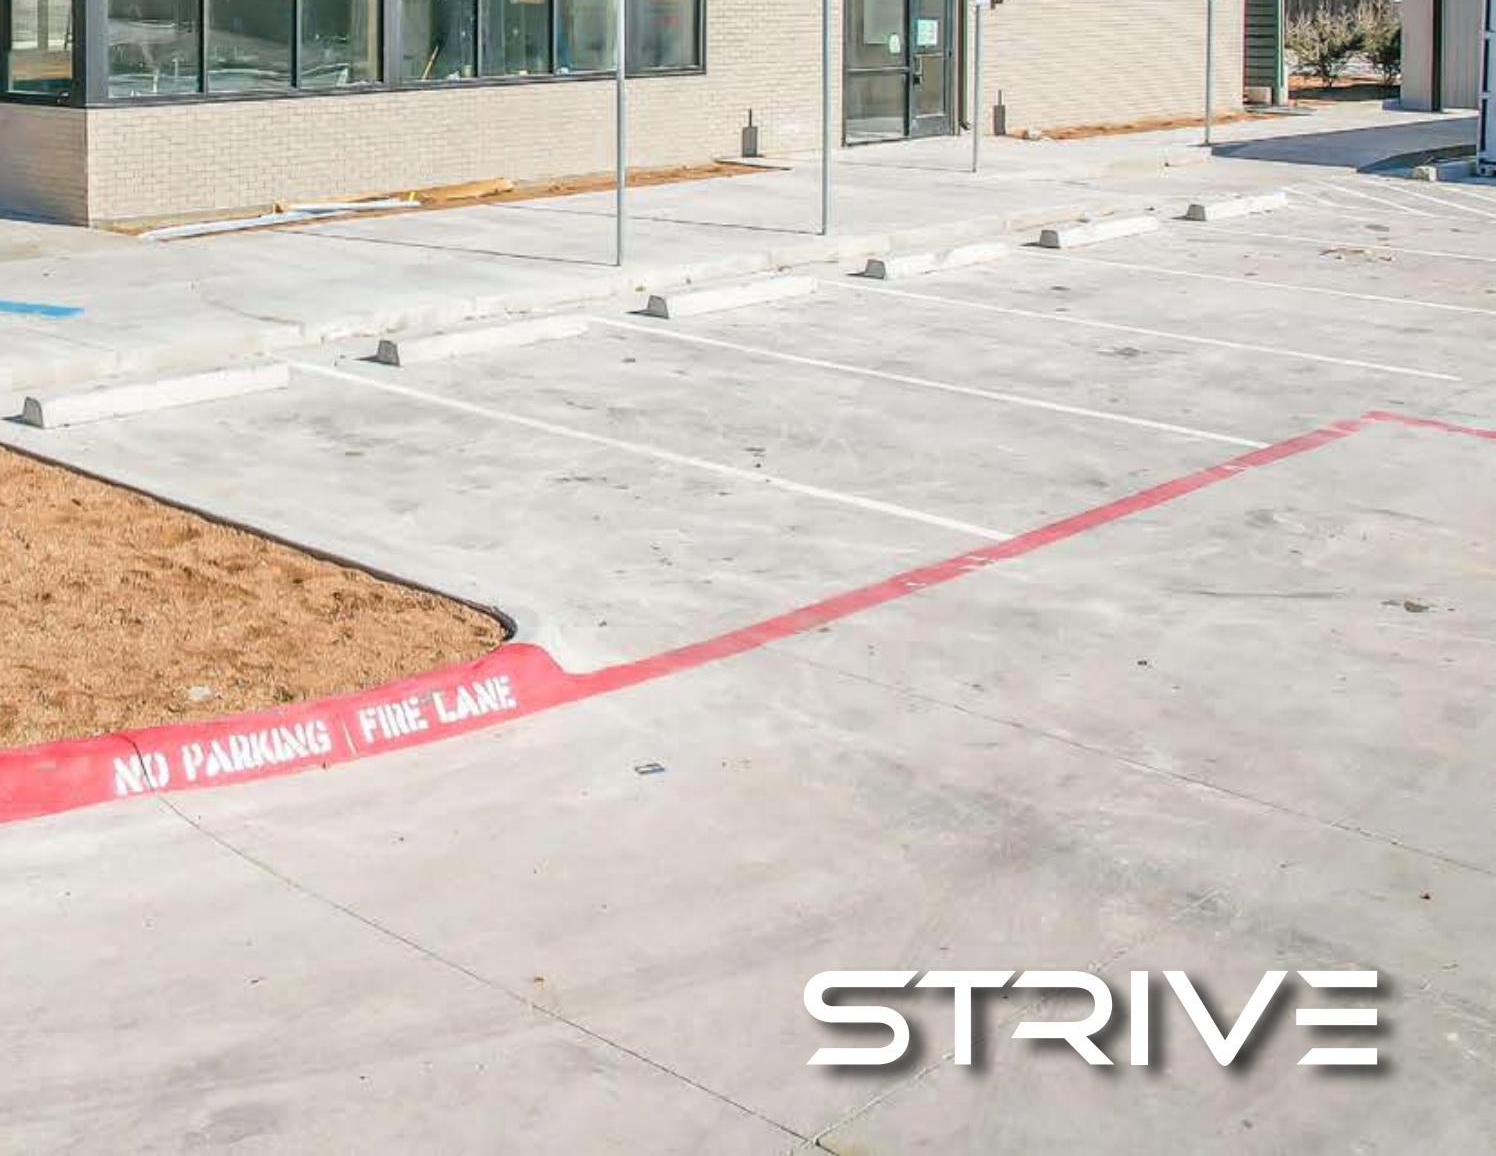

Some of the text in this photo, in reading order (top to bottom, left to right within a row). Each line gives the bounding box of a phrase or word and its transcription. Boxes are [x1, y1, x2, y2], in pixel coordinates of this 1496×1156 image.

[112, 676, 516, 797] NO PARKING FIRE LANE
